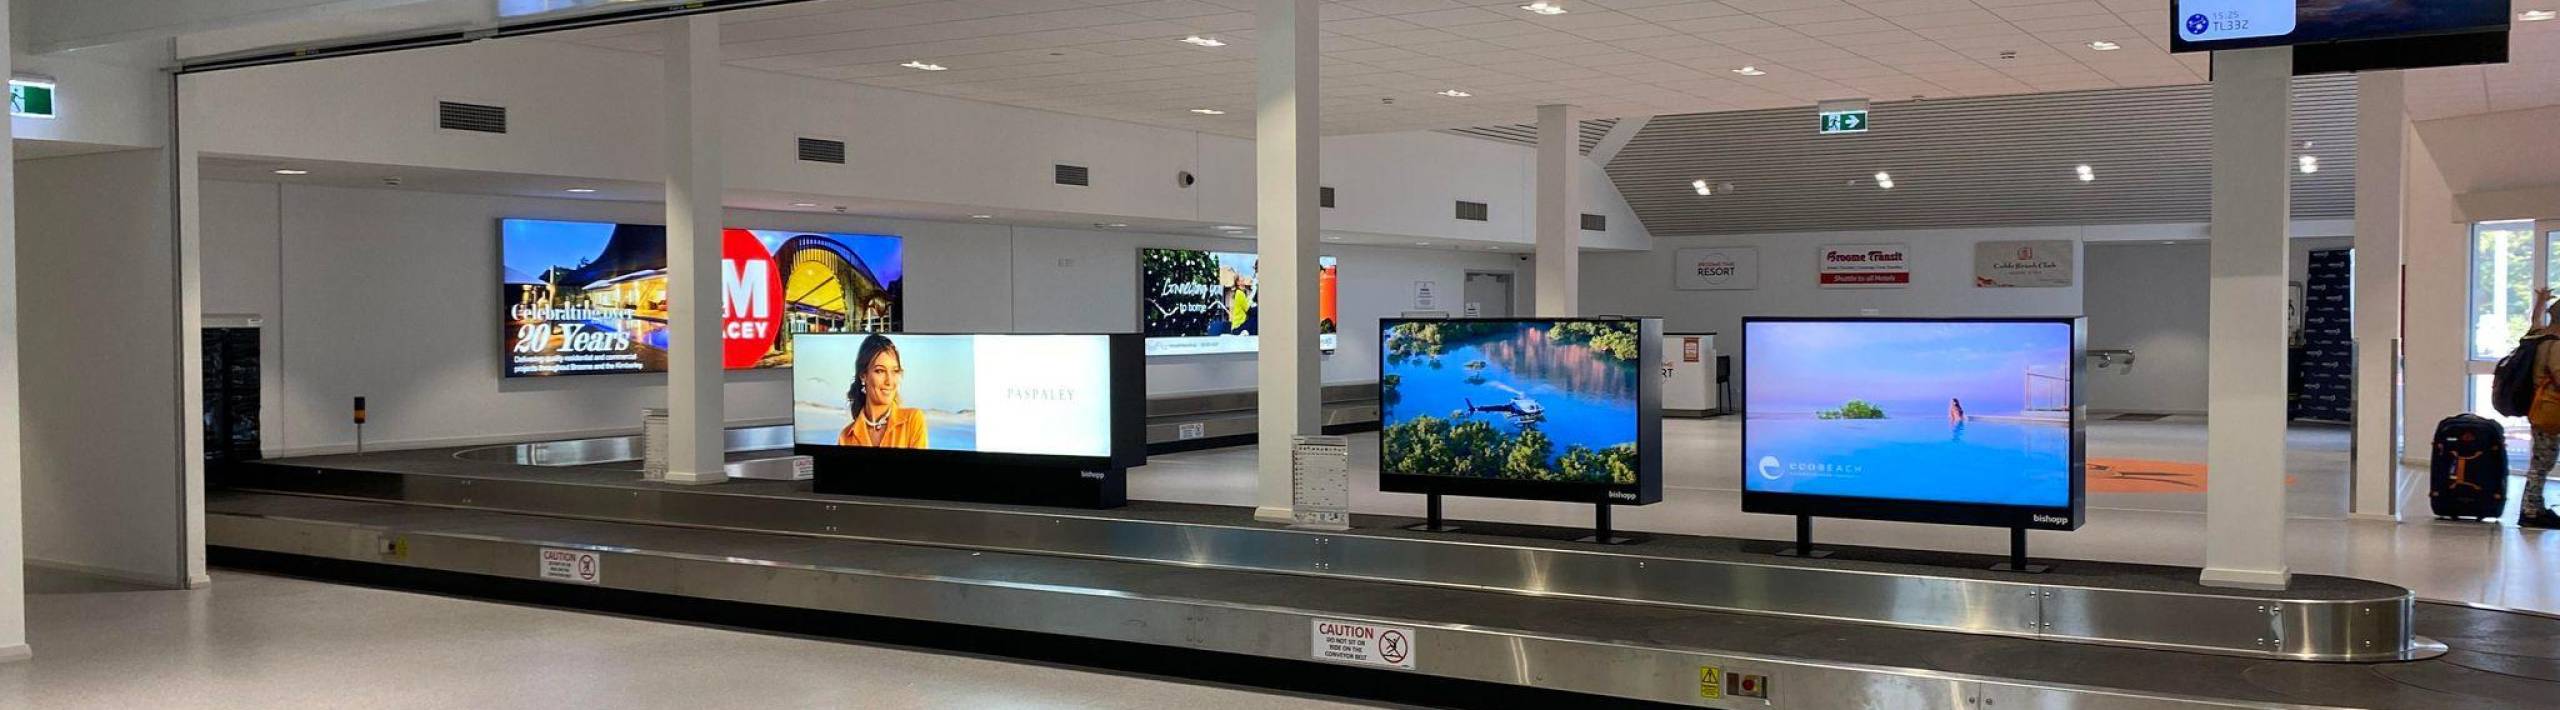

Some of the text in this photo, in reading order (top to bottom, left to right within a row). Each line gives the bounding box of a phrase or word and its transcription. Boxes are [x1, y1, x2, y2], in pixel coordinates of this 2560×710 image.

[2213, 20, 2249, 32] TL332
[1827, 250, 1904, 262] Broome Transit
[1697, 266, 1735, 277] RESORT
[514, 323, 630, 353] 20 Years
[1006, 387, 1075, 401] PASPALEY
[2033, 514, 2069, 526] bishopp
[1320, 623, 1374, 639] CAUTION
